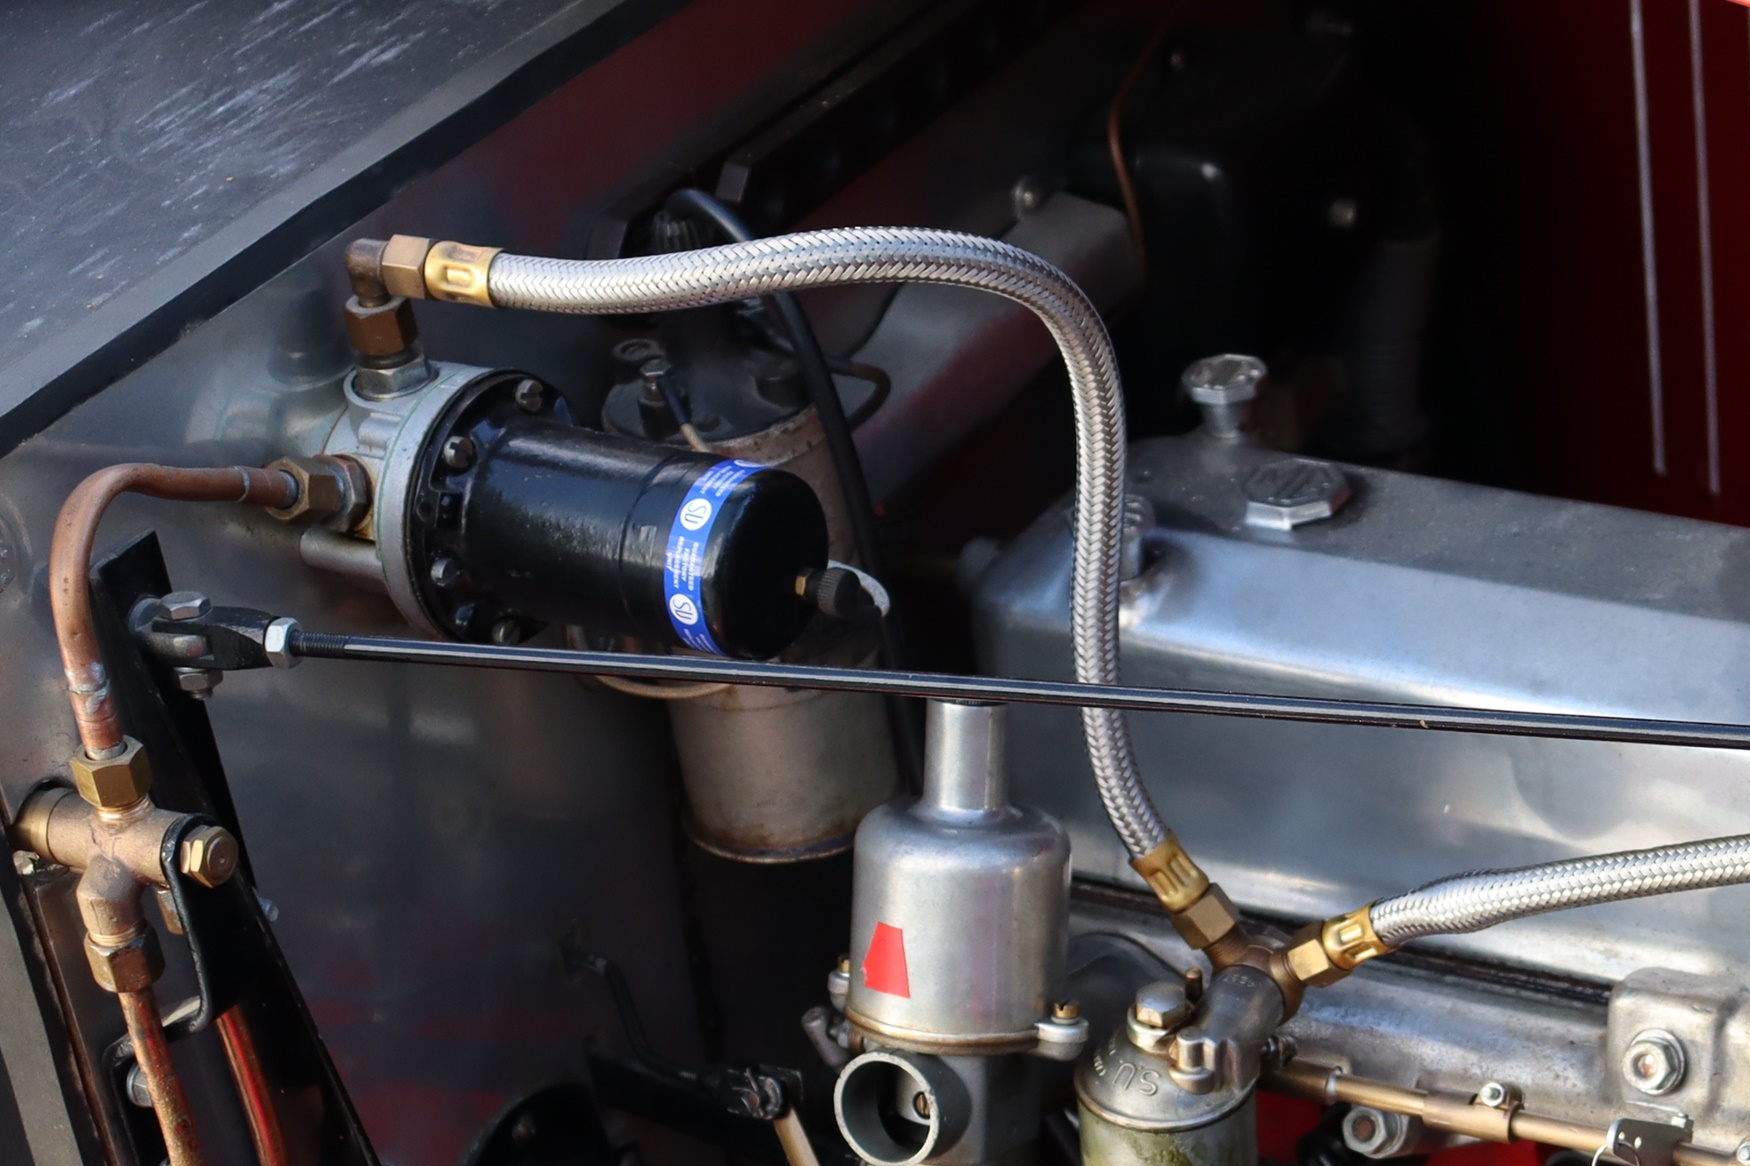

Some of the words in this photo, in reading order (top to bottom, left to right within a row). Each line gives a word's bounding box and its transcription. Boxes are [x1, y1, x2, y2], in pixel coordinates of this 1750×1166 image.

[684, 502, 707, 525] SU
[673, 536, 685, 589] REPLACEMENT
[681, 548, 691, 582] FACTORY
[687, 542, 699, 591] GUARANTEED
[672, 598, 694, 621] SU
